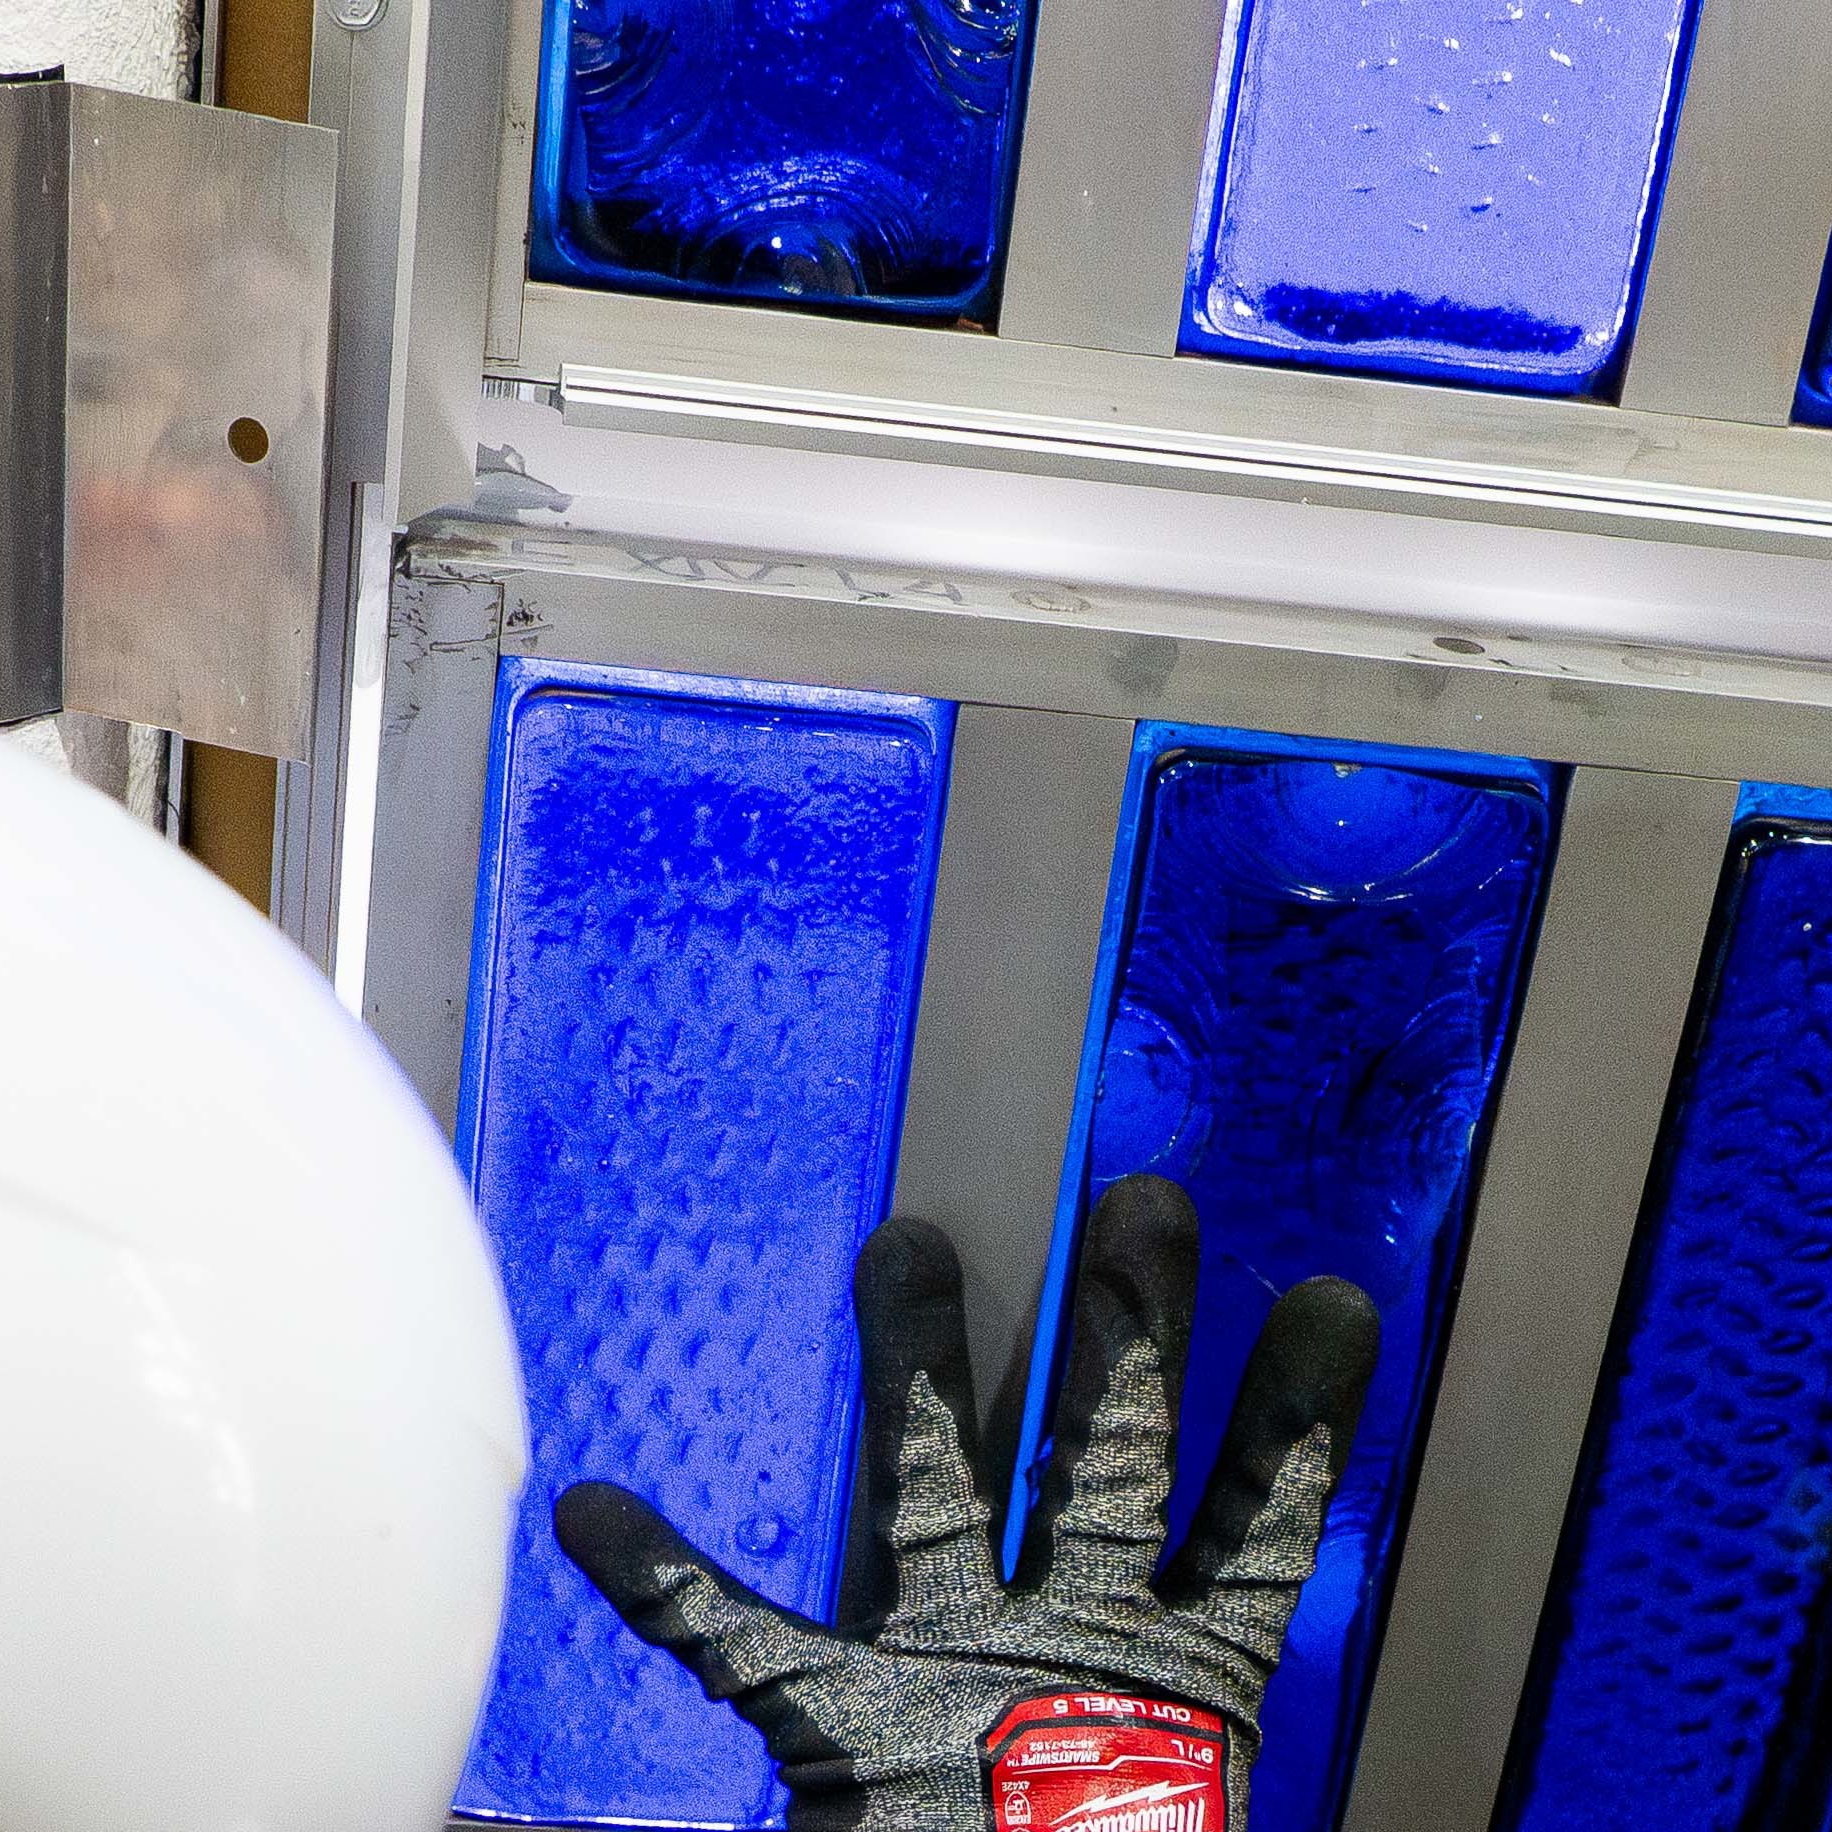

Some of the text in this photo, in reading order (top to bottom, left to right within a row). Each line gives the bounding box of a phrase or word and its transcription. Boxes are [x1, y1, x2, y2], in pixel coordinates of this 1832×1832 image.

[1052, 1696, 1191, 1722] CUT LEVEL 5
